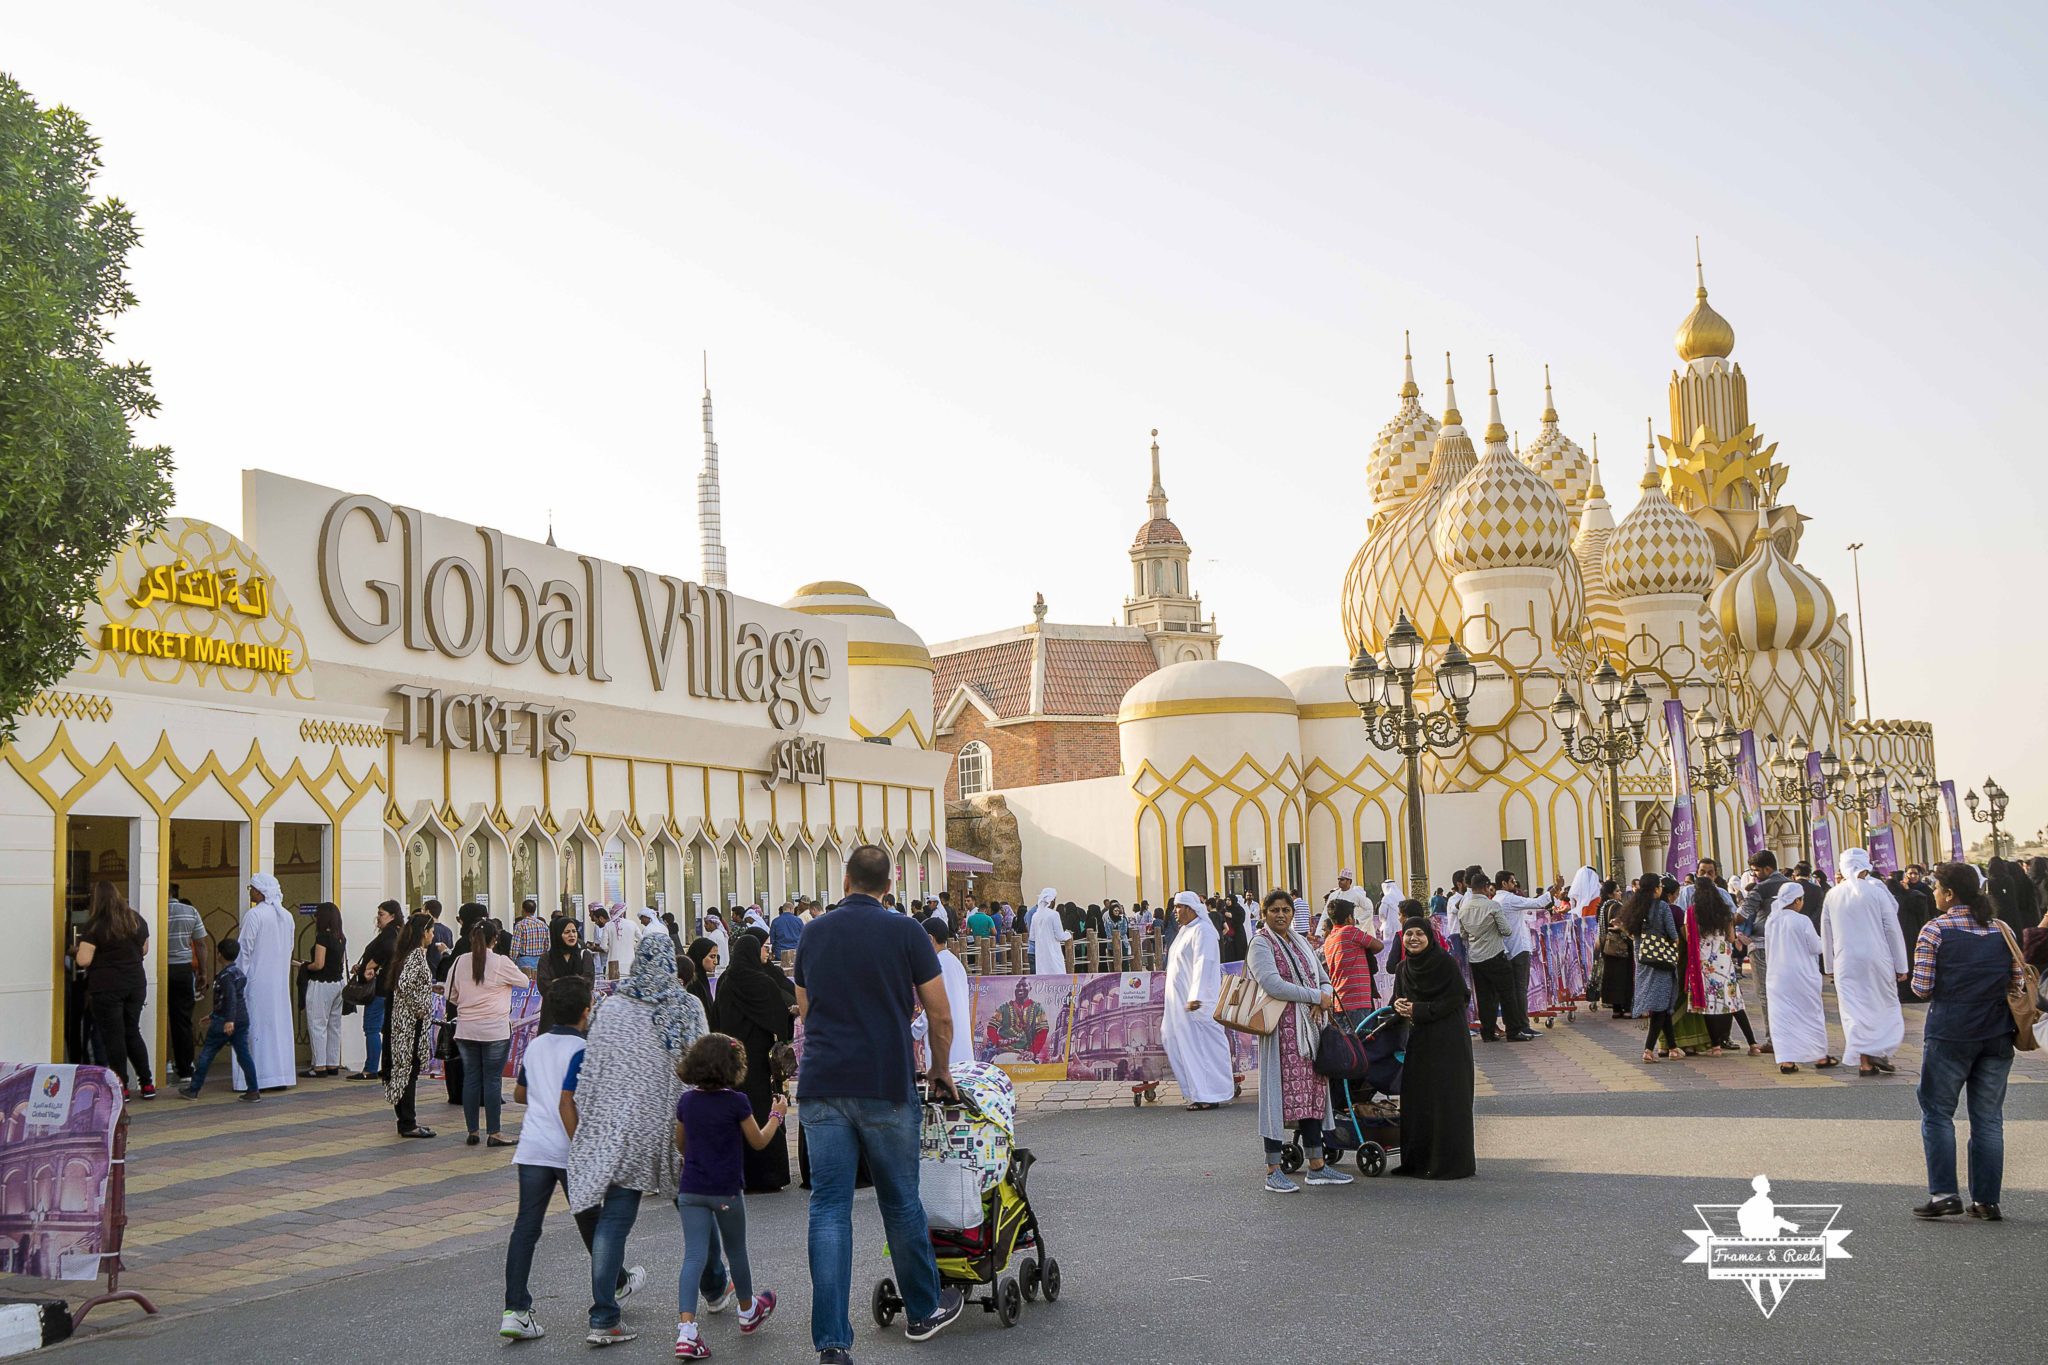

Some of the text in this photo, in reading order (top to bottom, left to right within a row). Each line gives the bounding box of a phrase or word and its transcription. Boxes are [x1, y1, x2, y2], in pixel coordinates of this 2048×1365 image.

[126, 560, 222, 611] التذاكر
[317, 494, 831, 731] Global Village
[101, 623, 295, 675] TICKET MACHINE
[390, 684, 577, 762] TICKETS
[761, 736, 827, 791] التذاكر
